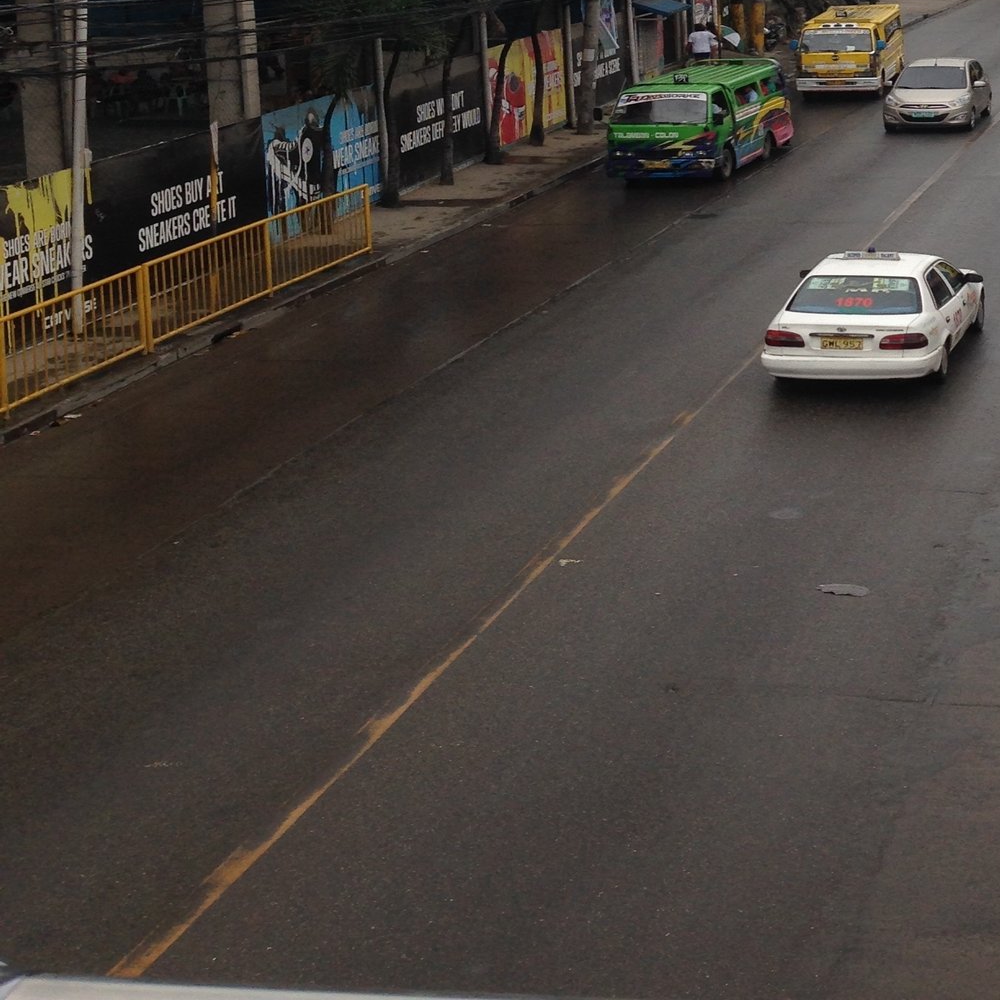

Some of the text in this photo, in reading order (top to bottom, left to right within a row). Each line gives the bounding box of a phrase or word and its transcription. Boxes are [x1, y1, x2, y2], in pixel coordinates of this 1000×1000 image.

[400, 125, 432, 154] SNEAKERS
[461, 106, 481, 130] WOULD
[151, 171, 224, 217] SHOES BUY AT
[3, 233, 31, 260] SHOES
[138, 195, 237, 252] SNEAKERS CRETE IT
